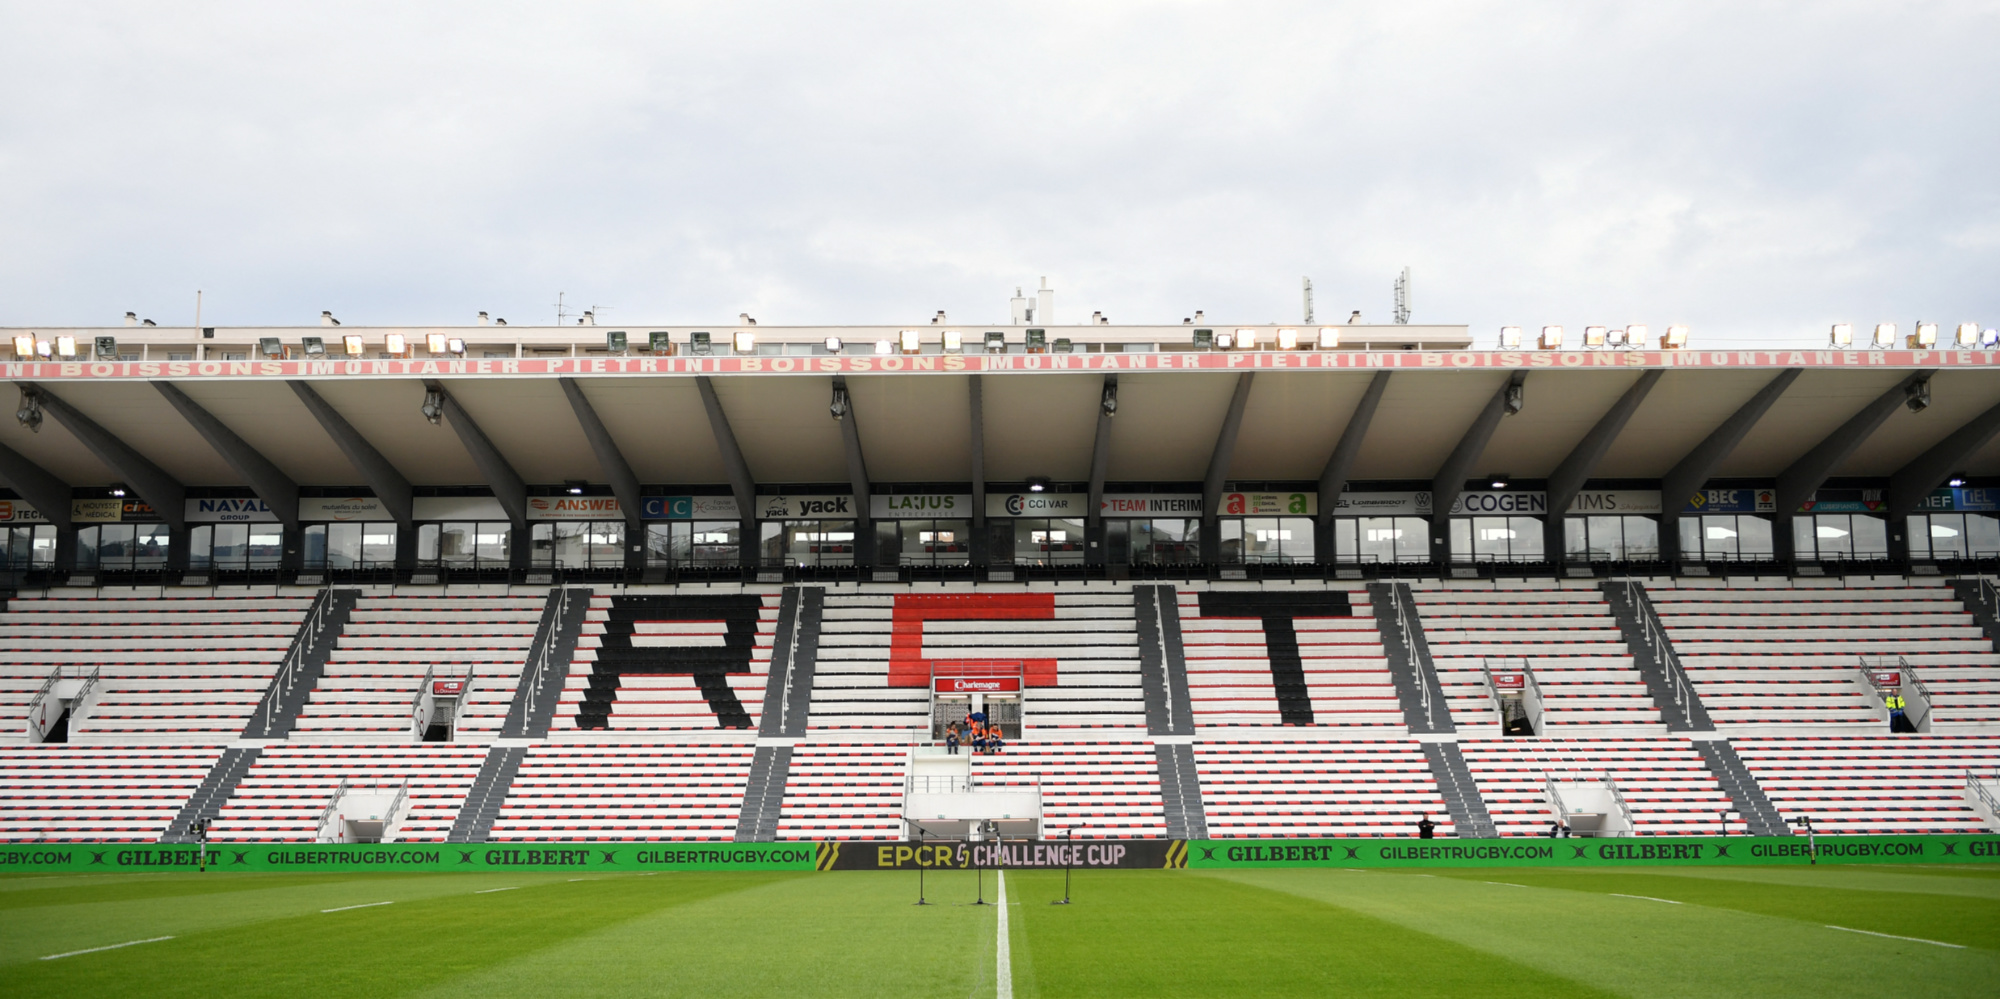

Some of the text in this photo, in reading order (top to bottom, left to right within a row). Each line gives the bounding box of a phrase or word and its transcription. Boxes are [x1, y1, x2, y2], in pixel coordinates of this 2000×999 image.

[60, 362, 283, 376] BOISSONS
[311, 360, 519, 375] MONTANER
[546, 359, 721, 373] PIETRINI
[740, 357, 966, 372] BOISSONS
[990, 355, 1200, 370] MONTANER
[1227, 354, 1402, 367] PIETRINI
[1421, 352, 1646, 366] BOISSONS
[1677, 352, 1886, 365] MONTANER
[1465, 494, 1545, 511] COGEN
[1577, 494, 1616, 510] IMS
[1708, 490, 1739, 504] BEC
[1862, 489, 1882, 502] YORK
[199, 500, 271, 512] NAVAL
[646, 500, 687, 515] CIC
[1028, 500, 1068, 508] CCI VAR
[1110, 499, 1202, 511] TEAM INTERIM
[765, 508, 789, 518] yack
[1197, 591, 1353, 726] T
[955, 680, 1000, 690] Charlemagne
[117, 850, 221, 866] GILBERT
[268, 851, 439, 864] GILBERTRUGBY.COM
[486, 850, 590, 865] GILBERT
[637, 850, 810, 864] GILBERTRUGBY.COM
[877, 844, 1126, 867] EPCR CHALLENGE CUP
[1228, 847, 1332, 861] GILBERT
[1380, 846, 1552, 860] GILBERTRUGBY.COM
[1599, 846, 1704, 861] GILBERT
[1751, 844, 1923, 858] GILBERTRUGBY.COM
